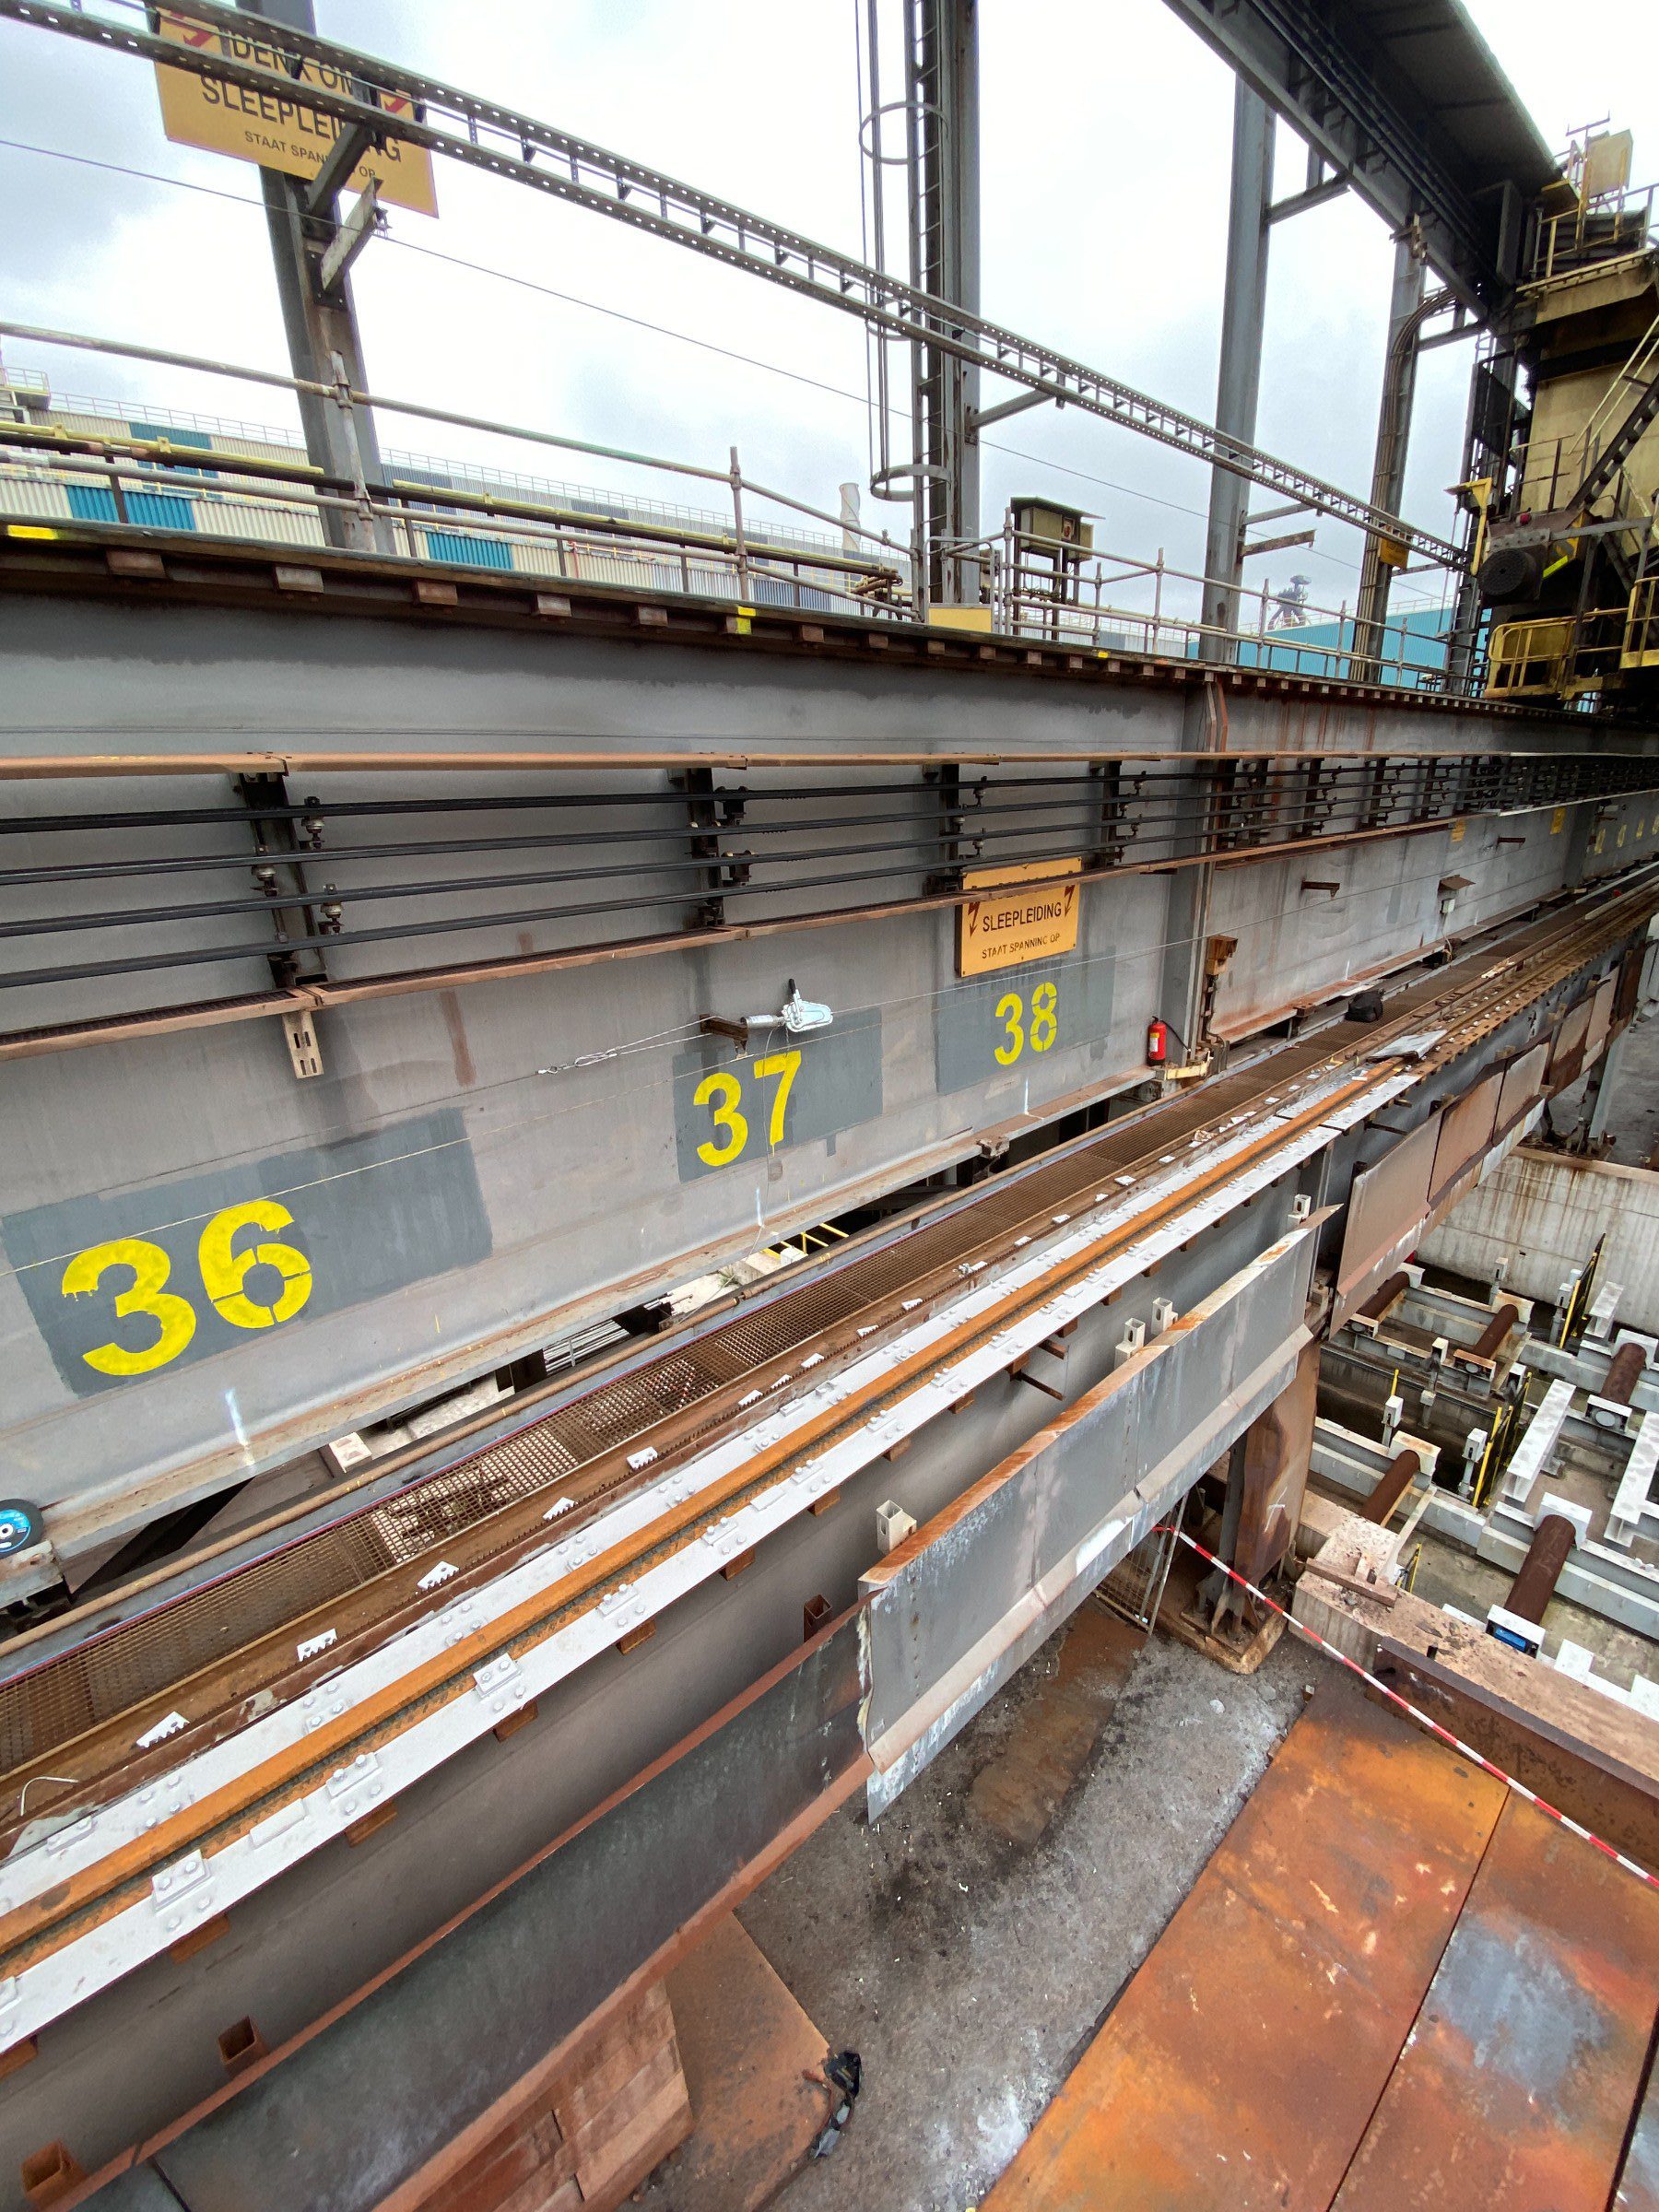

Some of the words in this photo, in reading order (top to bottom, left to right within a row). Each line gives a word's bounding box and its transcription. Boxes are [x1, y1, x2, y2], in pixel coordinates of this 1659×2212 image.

[245, 131, 287, 152] STAAT
[982, 901, 1062, 932] SLEEPLEIDING
[982, 944, 1007, 959] STAAT
[1050, 933, 1060, 943] OP
[994, 982, 1057, 1065] 38
[693, 1050, 802, 1166] 37
[62, 1200, 312, 1376] 36
